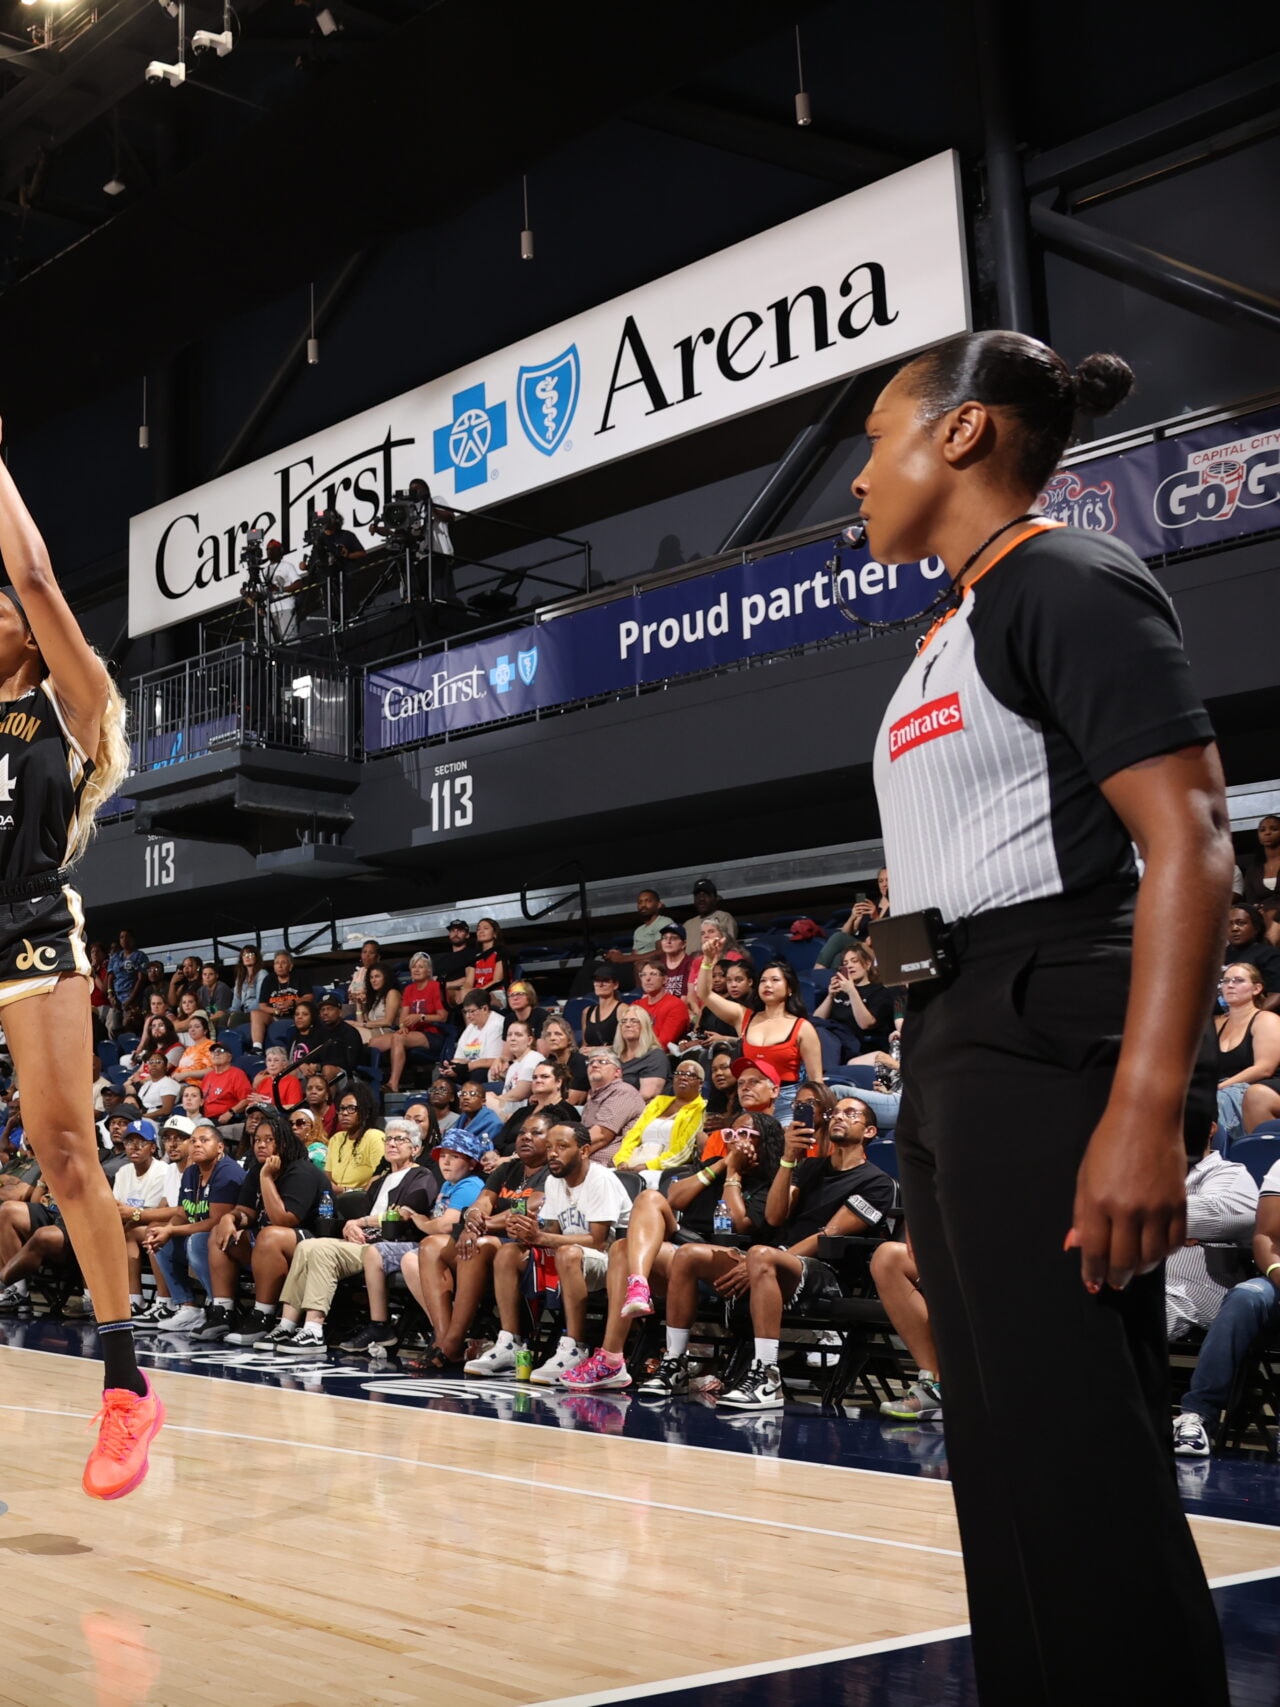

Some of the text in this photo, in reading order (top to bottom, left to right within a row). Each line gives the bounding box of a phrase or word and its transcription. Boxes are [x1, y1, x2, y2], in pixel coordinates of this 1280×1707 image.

[155, 261, 899, 600] CareFirst Arena
[1192, 443, 1247, 466] CAPITAL
[619, 592, 730, 660] Proud
[741, 561, 899, 640] partner
[384, 664, 487, 721] CareFirst
[890, 704, 961, 752] Emirates
[434, 760, 468, 776] SECTION
[430, 775, 473, 832] 113
[145, 841, 175, 888] 113
